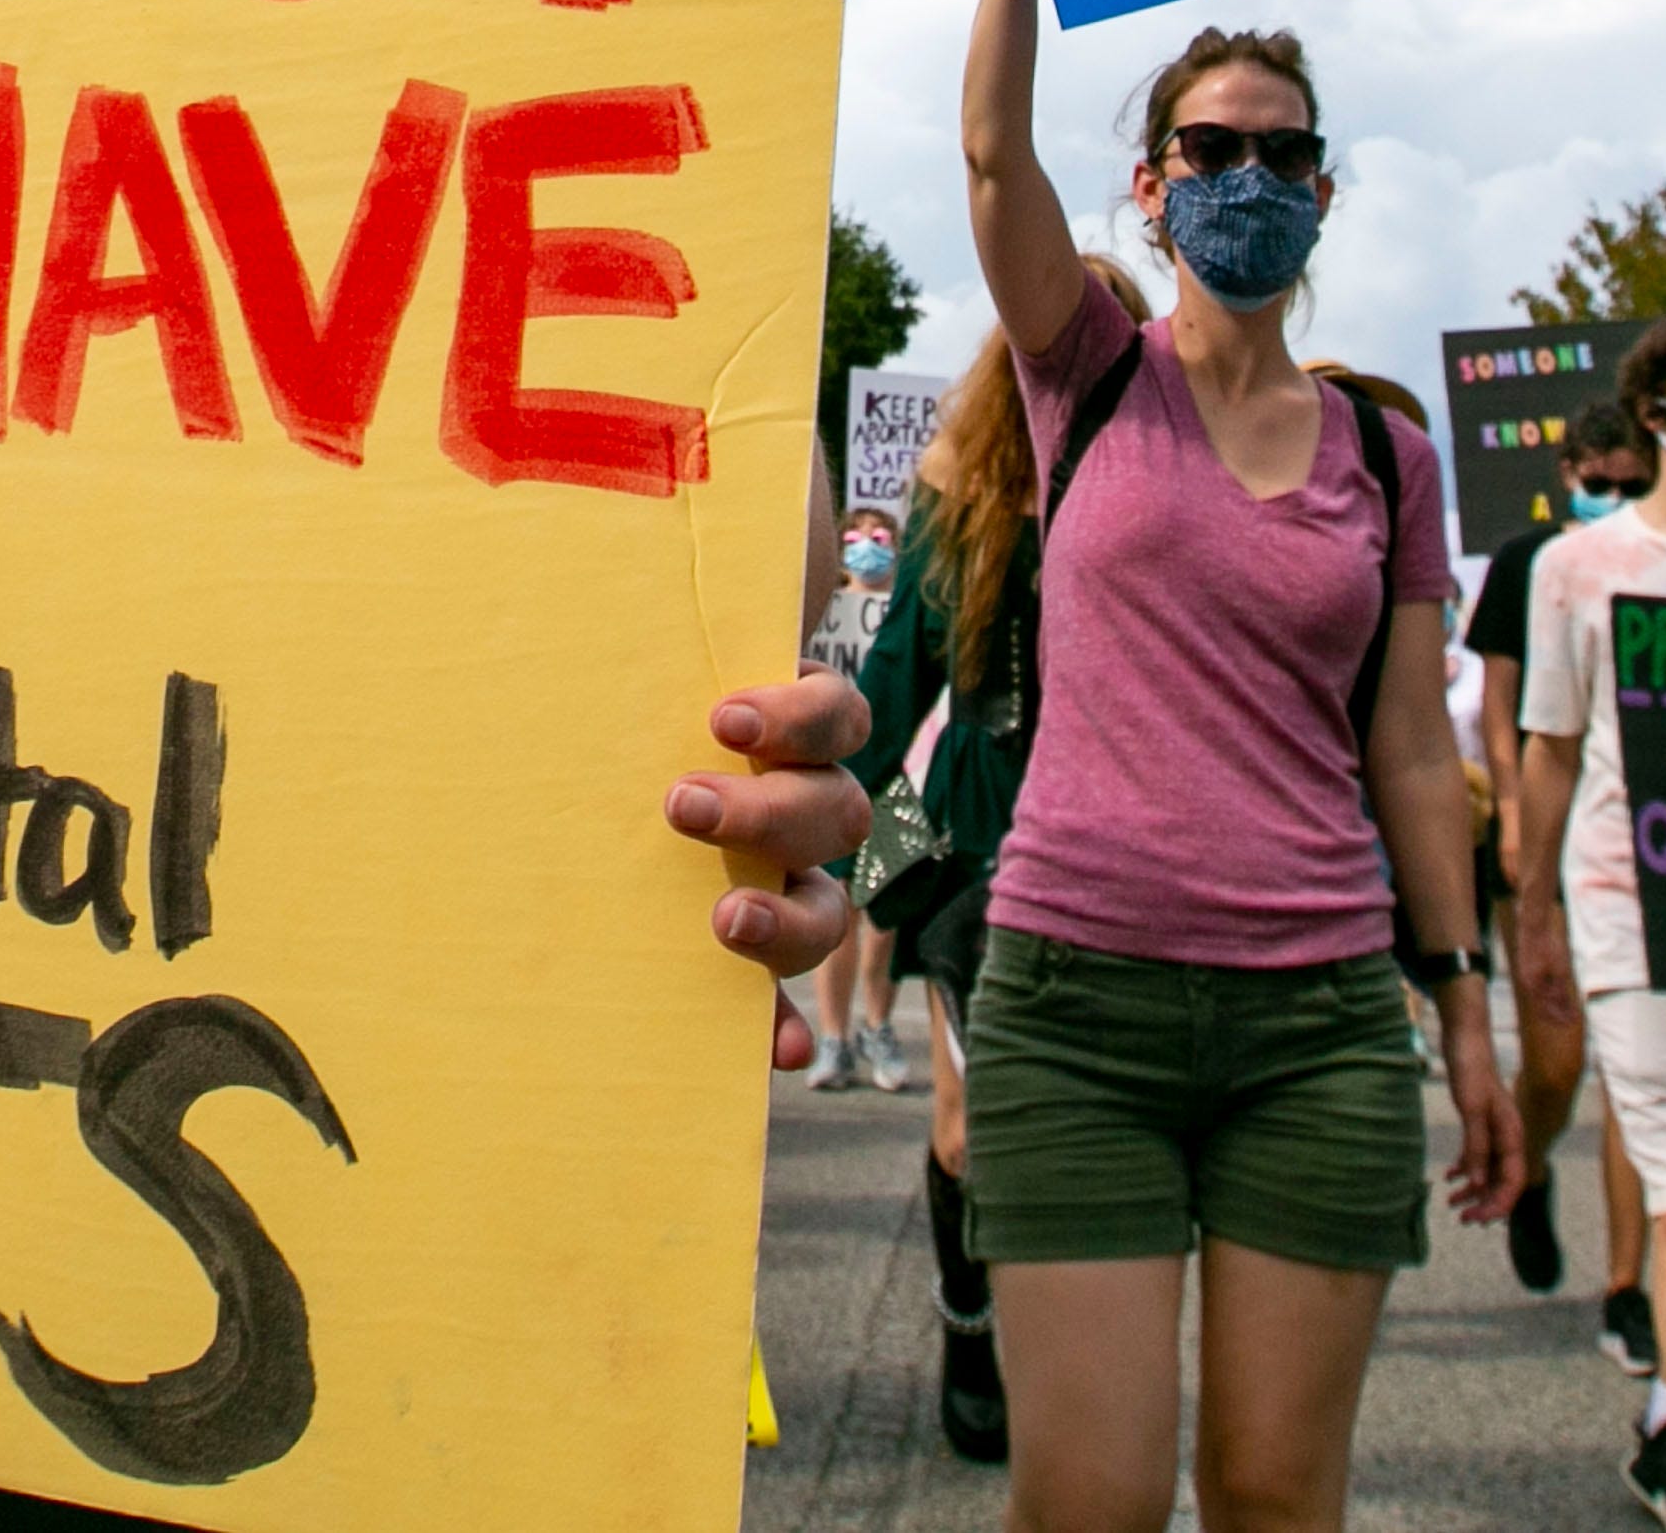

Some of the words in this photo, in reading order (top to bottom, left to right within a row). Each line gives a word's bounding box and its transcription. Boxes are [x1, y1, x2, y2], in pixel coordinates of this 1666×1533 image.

[1458, 342, 1594, 384] SOMEONE
[865, 391, 937, 426] KEEP
[1480, 416, 1567, 449] KNOW
[1532, 492, 1552, 522] A
